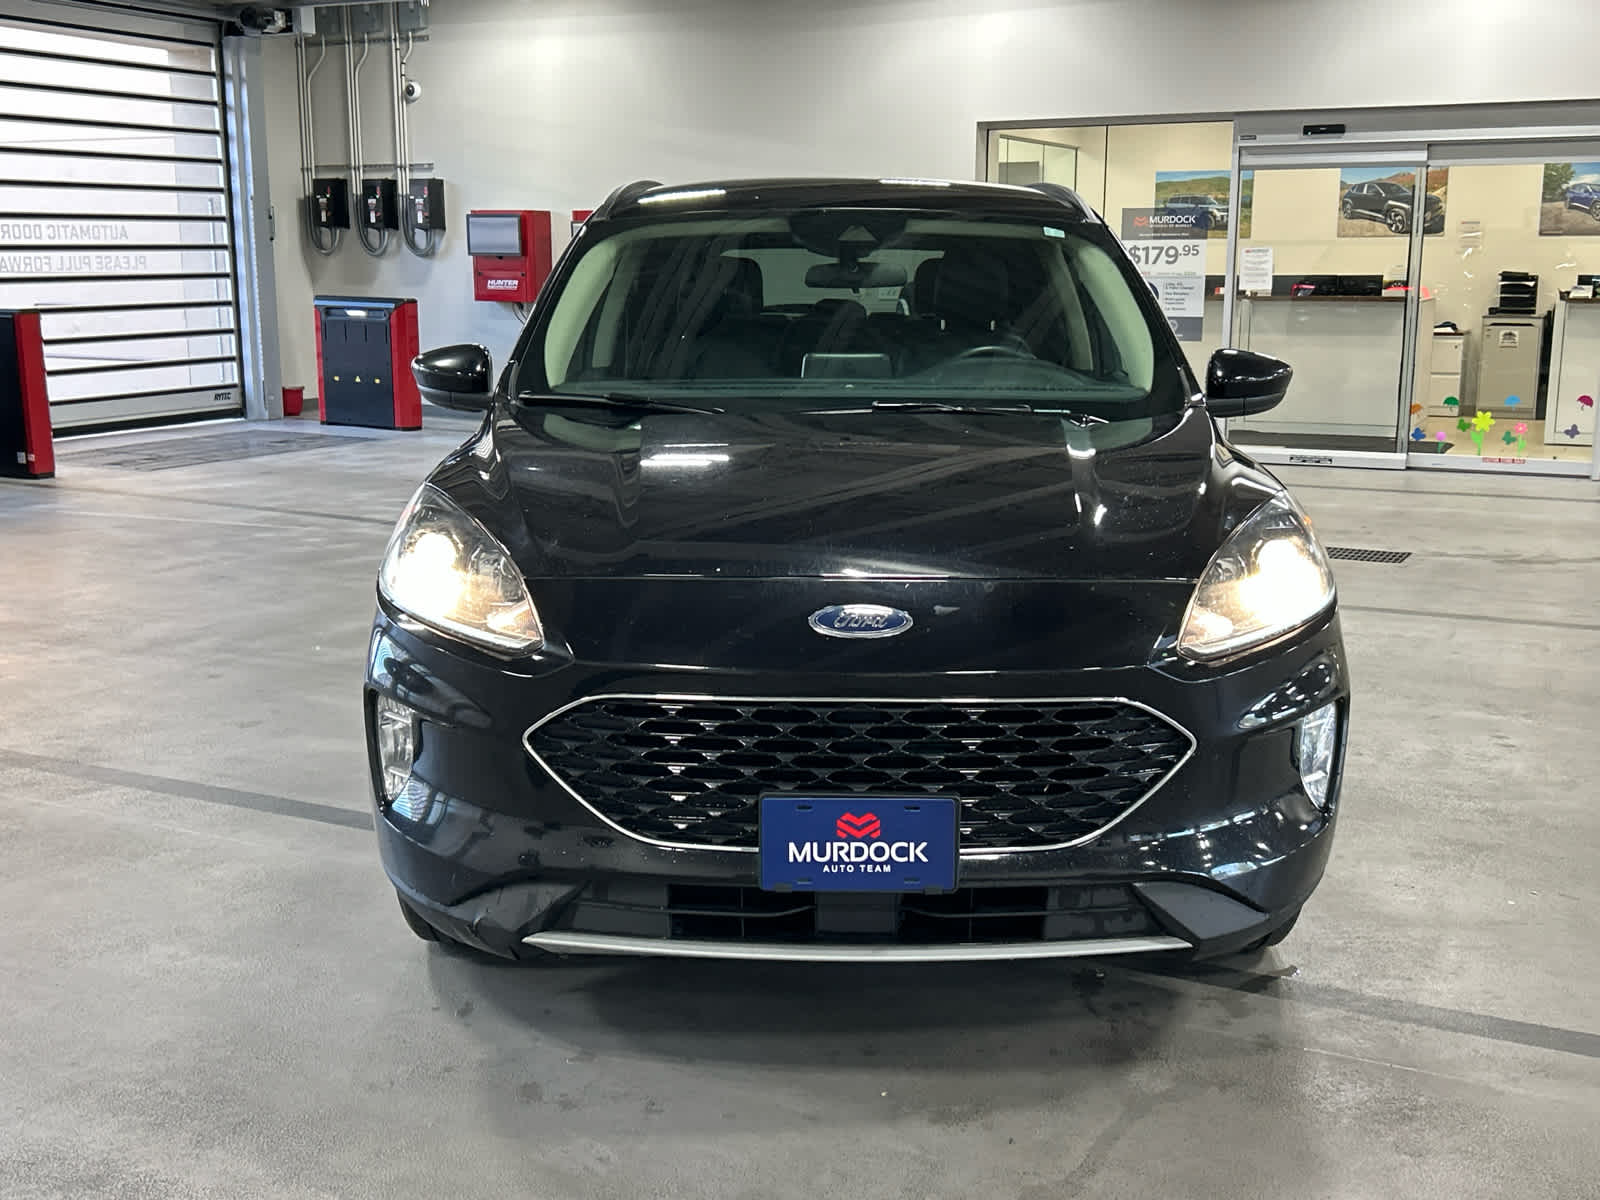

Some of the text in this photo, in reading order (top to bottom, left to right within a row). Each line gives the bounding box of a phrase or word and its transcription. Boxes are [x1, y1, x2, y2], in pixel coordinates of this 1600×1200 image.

[1149, 215, 1196, 224] MURDOCK
[487, 279, 518, 287] HUNTER
[833, 611, 889, 629] Ford
[788, 841, 929, 863] MURDOCK
[822, 864, 892, 873] AUTO TEAM
